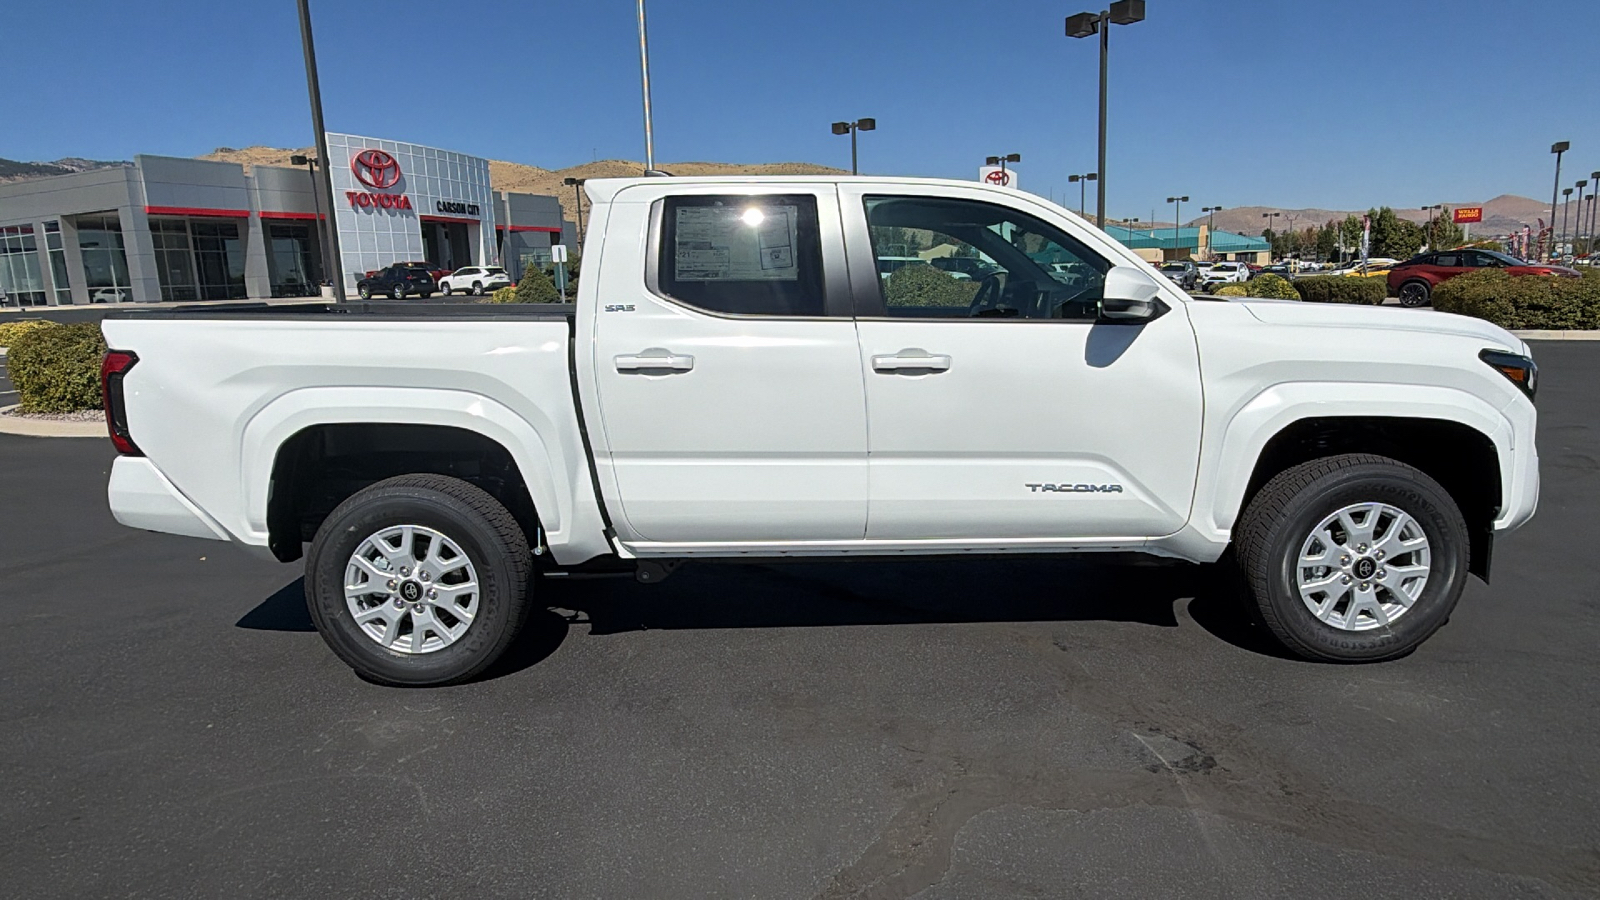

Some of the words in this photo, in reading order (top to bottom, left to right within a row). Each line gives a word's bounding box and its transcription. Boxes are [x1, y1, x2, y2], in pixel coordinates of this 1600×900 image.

[345, 191, 412, 210] TOYOTA
[436, 200, 466, 214] CARSON
[467, 203, 480, 216] CITY
[1025, 483, 1123, 493] TACOMA
